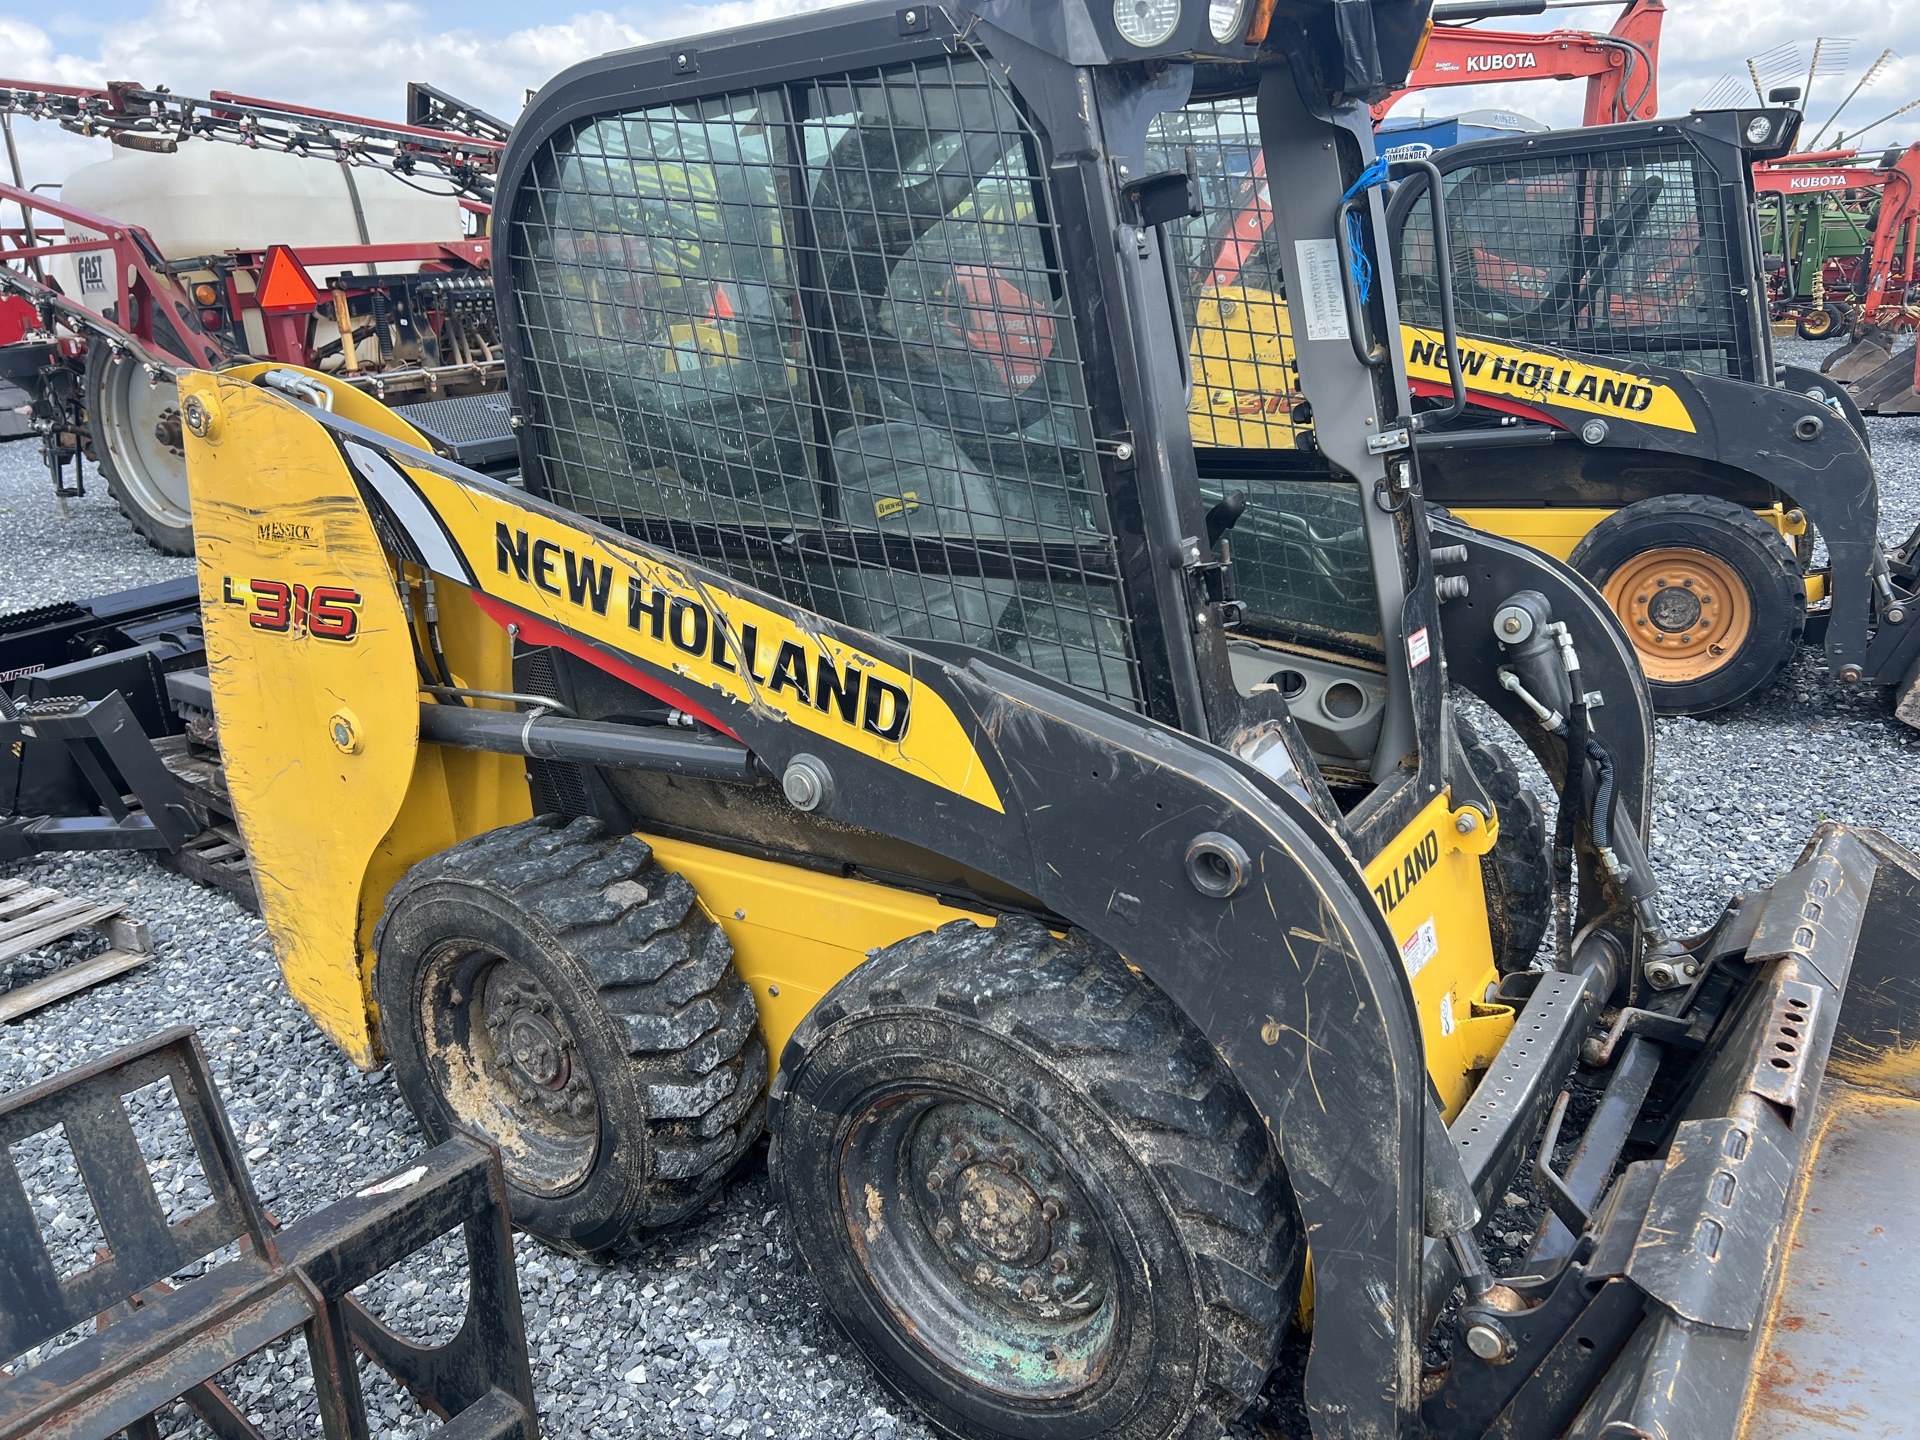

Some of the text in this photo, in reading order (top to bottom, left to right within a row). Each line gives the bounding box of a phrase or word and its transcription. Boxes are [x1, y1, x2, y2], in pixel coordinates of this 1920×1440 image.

[1467, 53, 1536, 72] KUBOTA
[1494, 114, 1518, 125] KINZE
[1790, 175, 1847, 189] KUBOTA
[78, 255, 102, 295] FAST
[1492, 356, 1654, 412] HOLLAND
[496, 519, 911, 743] NEW HOLLAND
[1373, 828, 1439, 916] OLLAND
